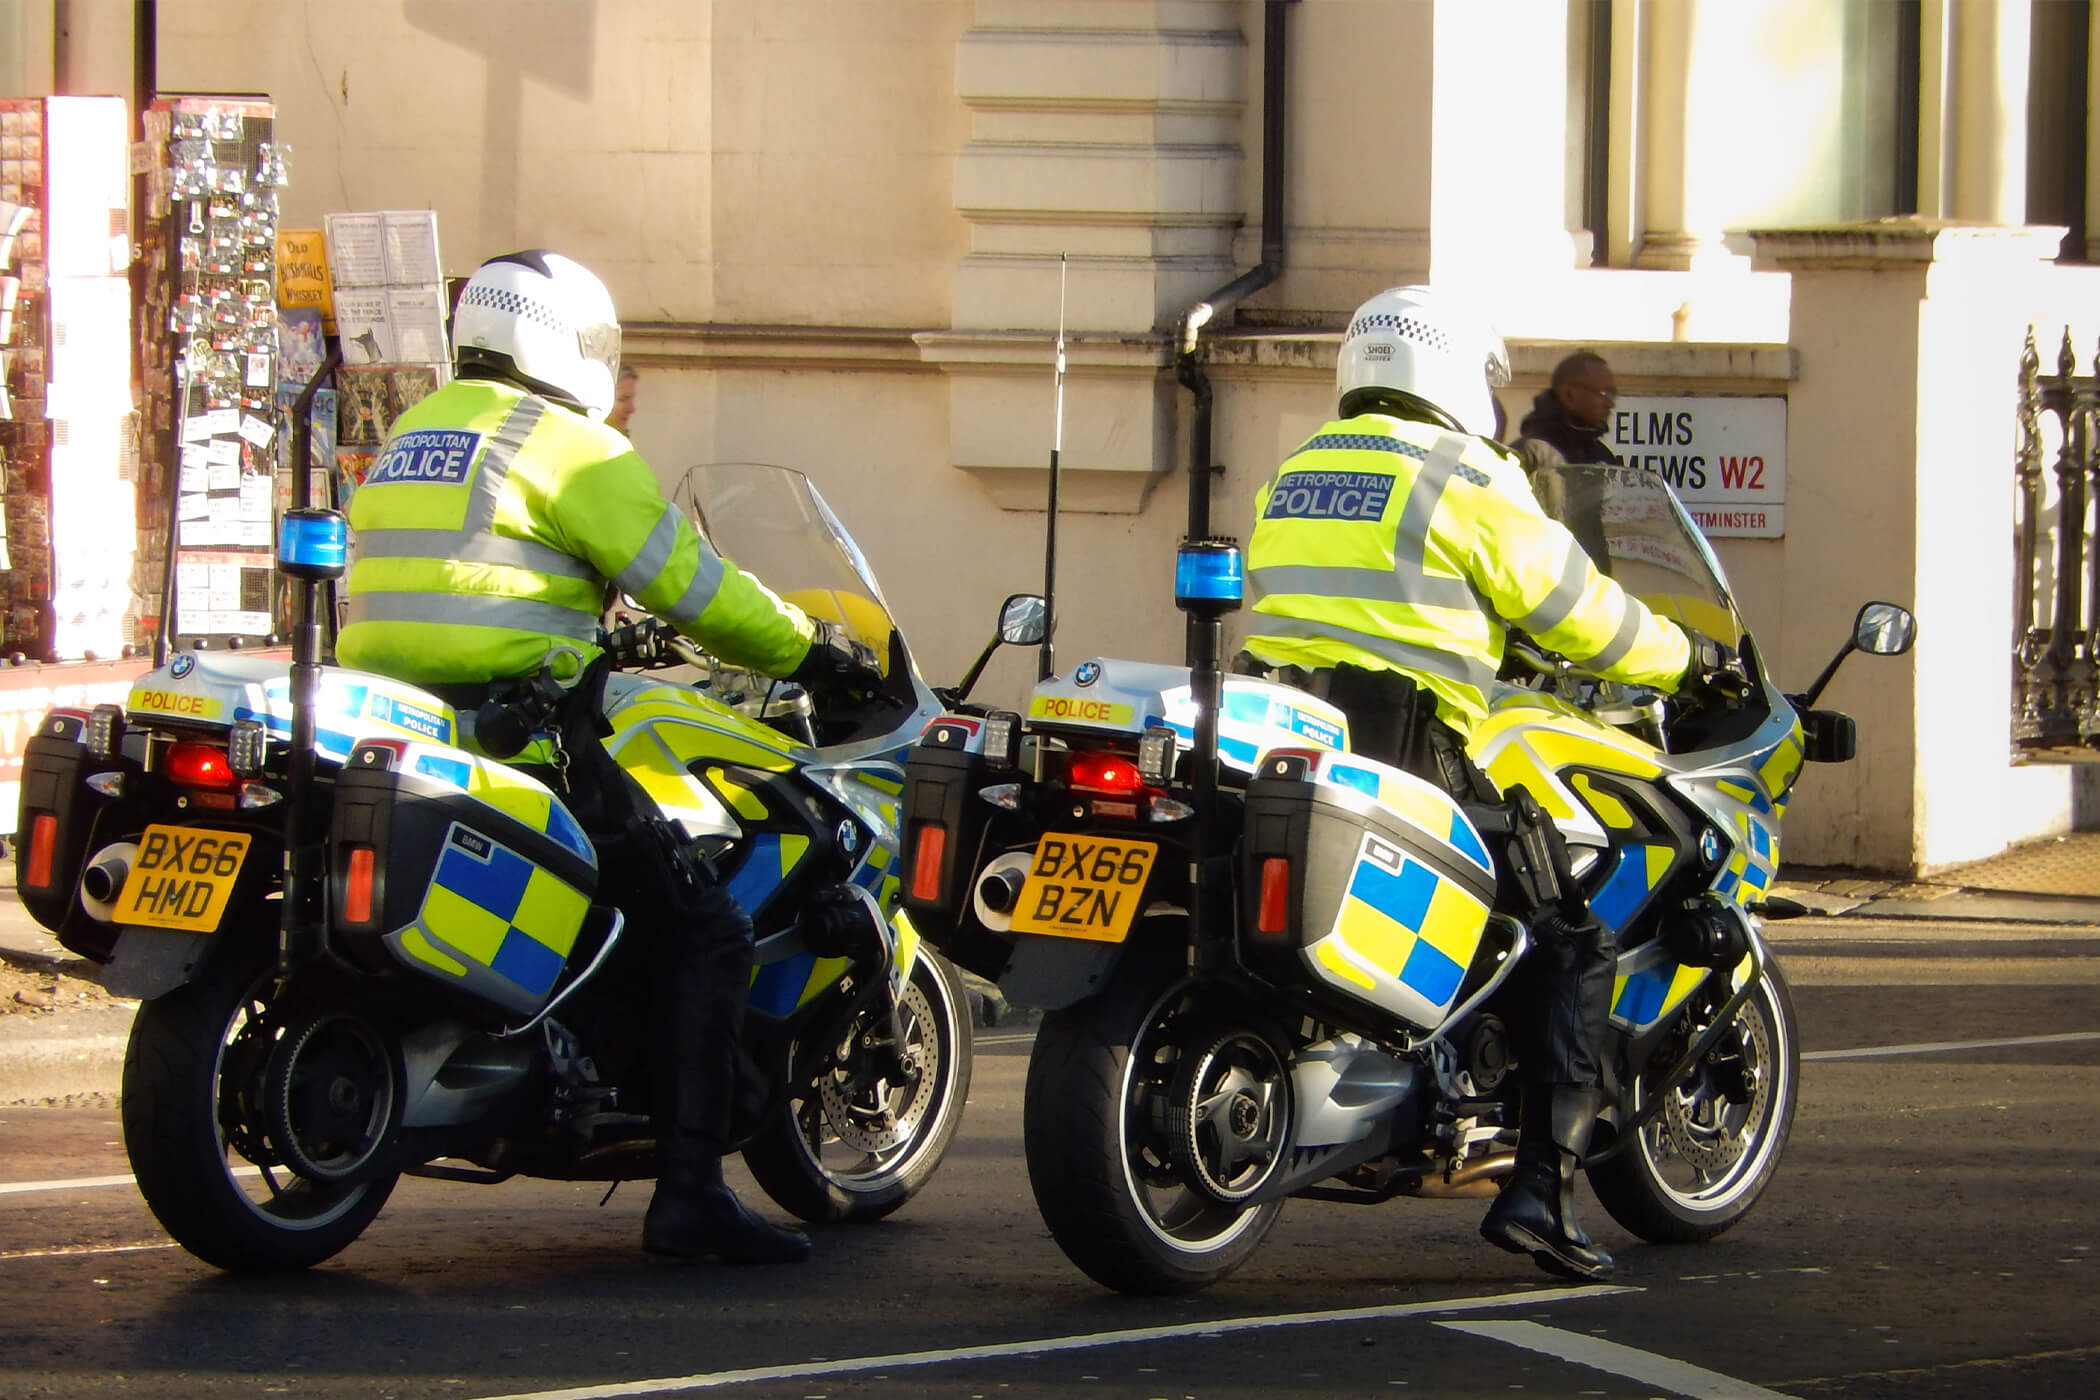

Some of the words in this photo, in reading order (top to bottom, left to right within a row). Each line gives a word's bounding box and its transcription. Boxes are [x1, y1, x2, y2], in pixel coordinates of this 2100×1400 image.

[1615, 412, 1693, 445] ELMS
[373, 449, 465, 478] POLICE
[1719, 456, 1765, 489] W2
[1279, 473, 1393, 490] METROPOLITAN
[1265, 488, 1387, 517] POLICE
[1691, 511, 1766, 528] STMINSTER
[142, 692, 204, 713] POLICE
[1044, 699, 1112, 720] POLICE
[403, 716, 438, 736] POLICE
[138, 833, 243, 877] BX66
[1033, 841, 1149, 884] BX66
[133, 876, 214, 918] HMD
[1032, 884, 1121, 927] BZN
